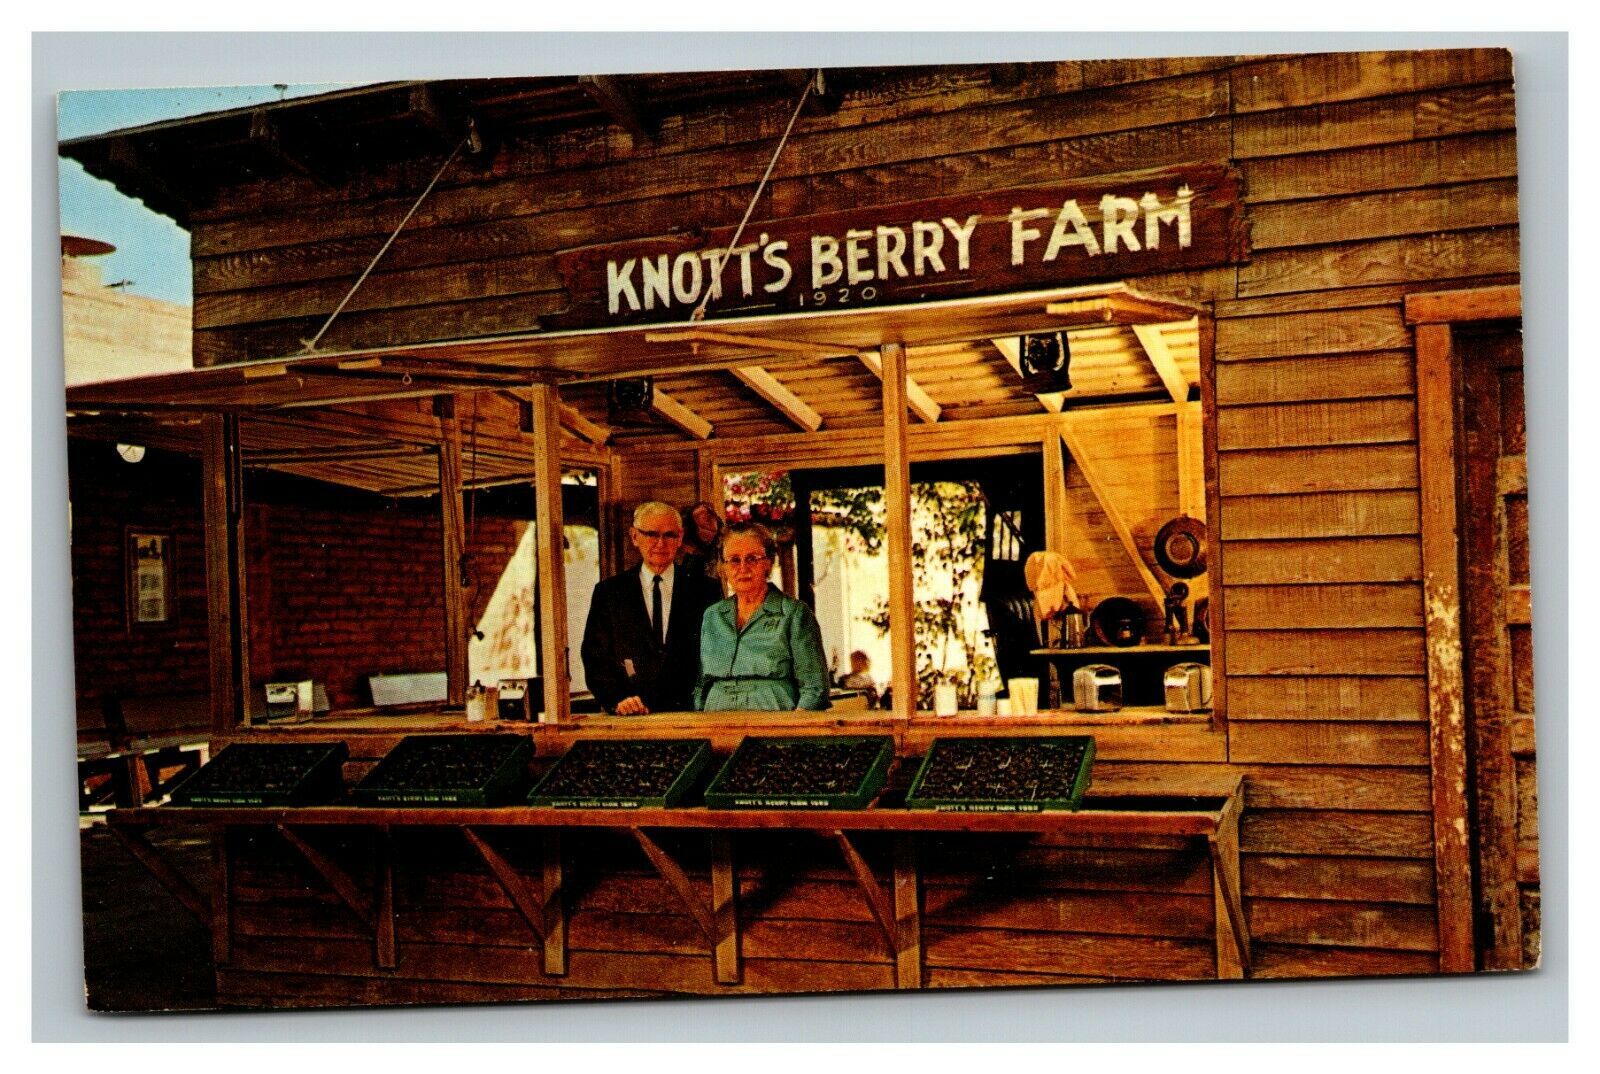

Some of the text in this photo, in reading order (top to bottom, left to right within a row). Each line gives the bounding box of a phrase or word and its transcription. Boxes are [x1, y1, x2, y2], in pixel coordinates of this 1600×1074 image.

[607, 184, 1193, 315] KNOTT'S BERRY FARM
[798, 286, 878, 307] 1920
